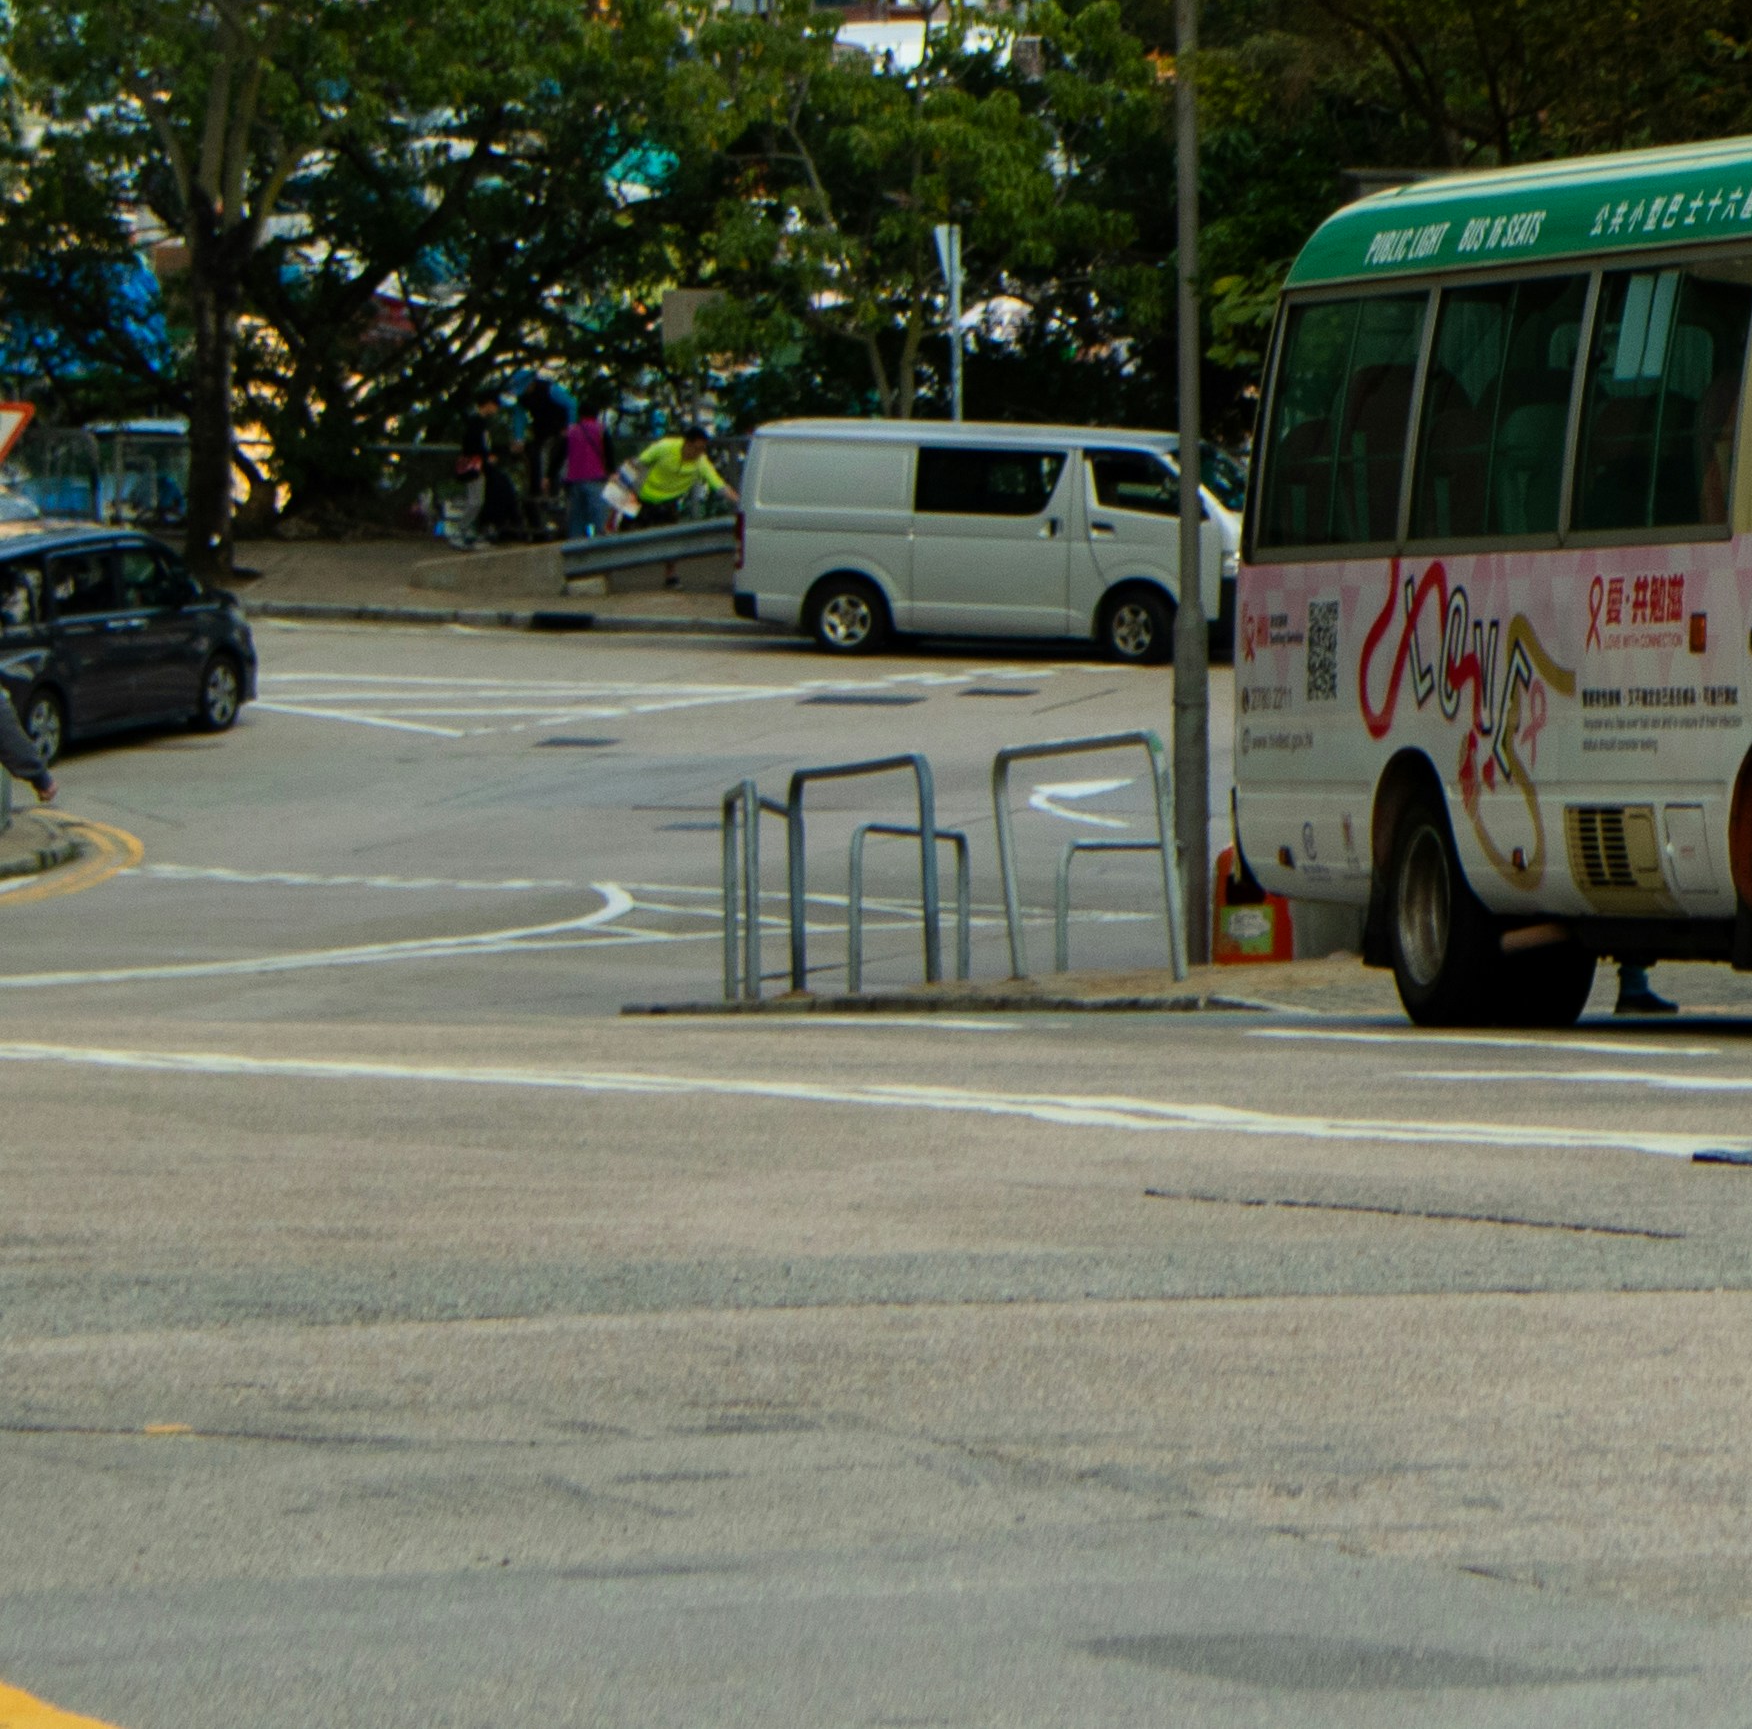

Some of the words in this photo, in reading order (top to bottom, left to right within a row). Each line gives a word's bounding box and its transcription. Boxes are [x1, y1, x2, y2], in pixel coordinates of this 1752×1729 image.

[1366, 230, 1413, 264] PUBLIC
[1409, 222, 1451, 260] LIGHT
[1458, 216, 1491, 252] BUS
[1502, 210, 1547, 249] SEATS
